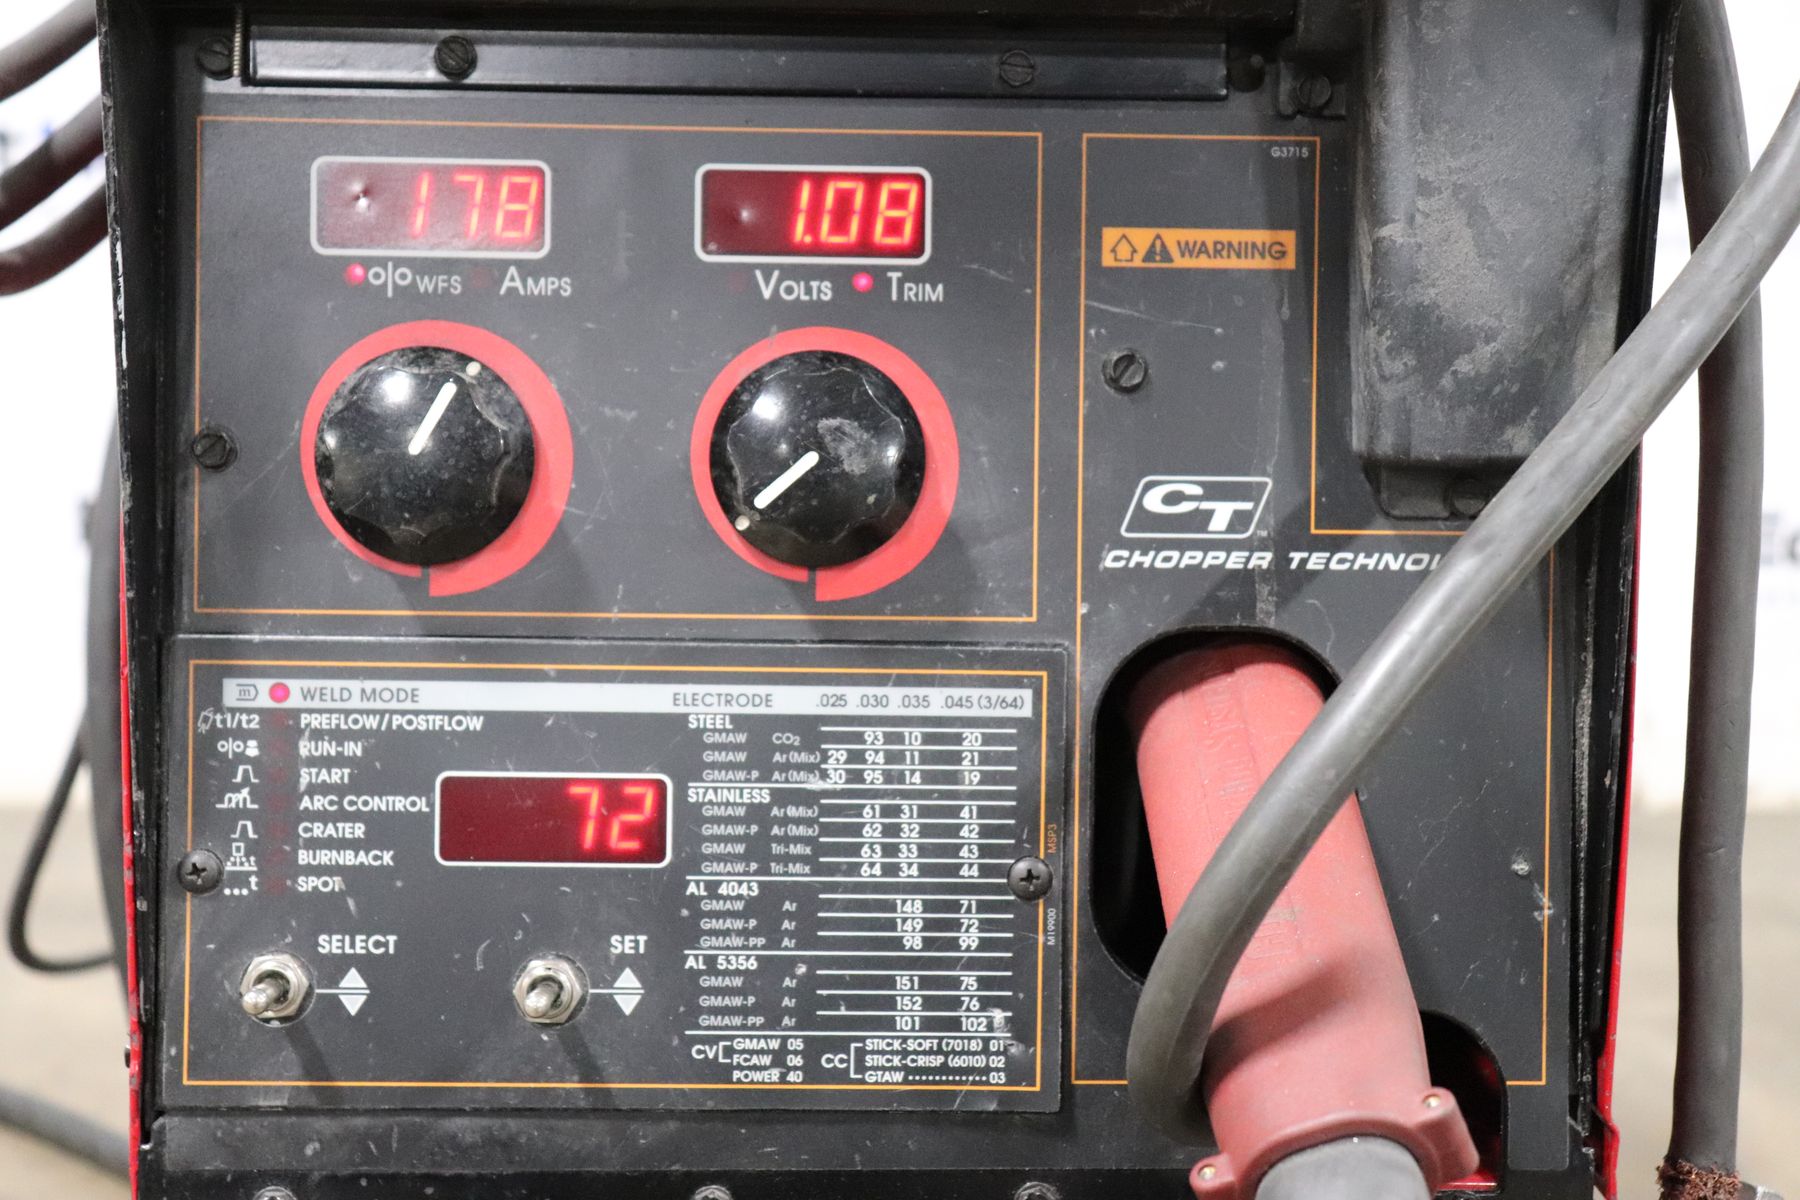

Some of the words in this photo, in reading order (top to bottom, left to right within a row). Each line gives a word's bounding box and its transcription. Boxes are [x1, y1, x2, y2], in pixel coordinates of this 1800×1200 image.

[1271, 147, 1308, 157] G3715
[409, 171, 540, 240] 178
[793, 180, 919, 245] 1.08
[1177, 239, 1287, 261] WARNING
[417, 275, 462, 294] WFS
[1142, 483, 1254, 531] CT
[1104, 550, 1272, 569] CHOPPER
[301, 687, 352, 702] WELD
[360, 688, 420, 703] MODE
[673, 693, 773, 707] ELECTRODE
[816, 694, 847, 707] .025
[856, 695, 889, 708] .030
[898, 695, 930, 709] .035
[940, 695, 973, 709] .045
[978, 695, 1024, 710] (3/64)
[214, 713, 260, 729] t1/t2
[301, 713, 484, 731] PREFLOW/POSTFLOW
[688, 715, 733, 729] STEEL
[703, 733, 747, 743] GMAW
[772, 733, 800, 745] CO2
[864, 732, 884, 745] 93
[904, 732, 921, 746] 10
[962, 733, 981, 746] 20
[300, 741, 362, 756] RUN-IN
[703, 752, 747, 762] GMAW
[772, 752, 787, 763] Ar
[789, 752, 821, 763] (Mix)
[827, 751, 847, 764] 29
[865, 751, 885, 764] 94
[905, 752, 919, 764] 11
[961, 752, 979, 765] 21
[300, 768, 350, 783] START
[702, 771, 759, 781] GMAW-P
[772, 771, 786, 781] Ar
[826, 770, 846, 783] 30
[864, 771, 883, 784] 95
[905, 771, 921, 784] 14
[964, 771, 981, 785] 19
[300, 795, 338, 811] ARC
[344, 796, 429, 812] CONTROL
[688, 789, 771, 803] STAINLESS
[568, 784, 657, 850] 72
[702, 806, 746, 817] GMAW
[771, 807, 785, 817] Ar
[787, 806, 818, 817] (Mix)
[863, 805, 881, 818] 61
[900, 805, 917, 818] 31
[960, 805, 977, 819] 41
[299, 822, 365, 838] CRATER
[702, 825, 758, 836] GMAW-P
[771, 826, 785, 836] Ar
[787, 825, 819, 836] (Mix)
[862, 824, 882, 837] 62
[900, 824, 920, 838] 32
[959, 825, 979, 839] 42
[298, 850, 394, 866] BURNBACK
[701, 844, 745, 854] GMAW
[771, 844, 811, 855] Tri-Mix
[861, 845, 882, 858] 63
[898, 845, 918, 858] 33
[959, 845, 979, 859] 43
[701, 863, 758, 874] GMAW-P
[770, 863, 810, 874] Tri-Mix
[861, 864, 882, 877] 64
[898, 864, 919, 877] 34
[959, 864, 979, 878] 44
[298, 877, 341, 891] SPOT
[686, 882, 707, 895] AL
[718, 882, 759, 896] 4043
[701, 900, 745, 911] GMAW
[782, 901, 797, 912] Ar
[896, 900, 923, 913] 148
[960, 900, 977, 913] 71
[701, 919, 757, 930] GMAW-P
[781, 920, 796, 931] Ar
[896, 919, 923, 932] 149
[960, 919, 979, 933] 72
[318, 935, 397, 954] SELECT
[611, 936, 647, 954] SET
[700, 937, 766, 948] GMAW-PP
[781, 937, 796, 948] Ar
[903, 937, 922, 950] 98
[959, 937, 979, 951] 99
[685, 956, 706, 969] AL
[717, 956, 758, 970] 5356
[700, 976, 744, 987] GMAW
[782, 977, 797, 988] Ar
[896, 976, 919, 990] 151
[960, 977, 978, 990] 75
[699, 996, 756, 1007] GMAW-P
[782, 997, 797, 1007] Ar
[896, 997, 922, 1010] 152
[960, 997, 980, 1011] 76
[699, 1016, 764, 1027] GMAW-PP
[782, 1016, 797, 1027] Ar
[896, 1017, 920, 1030] 101
[961, 1018, 987, 1031] 102
[733, 1038, 780, 1050] GMAW
[787, 1039, 803, 1050] 05
[865, 1039, 938, 1051] STICK-SOFT
[942, 1039, 982, 1051] (7018)
[989, 1040, 1005, 1052] 01
[692, 1045, 717, 1059] CV
[733, 1055, 772, 1066] FCAW
[787, 1055, 803, 1066] 06
[821, 1054, 848, 1068] CC
[865, 1055, 944, 1067] STICK-CRISP
[948, 1055, 986, 1067] (6010)
[989, 1056, 1005, 1068] 02
[733, 1071, 779, 1082] POWER
[786, 1071, 803, 1082] 40
[865, 1071, 904, 1083] GTAW
[989, 1071, 1005, 1083] 03
